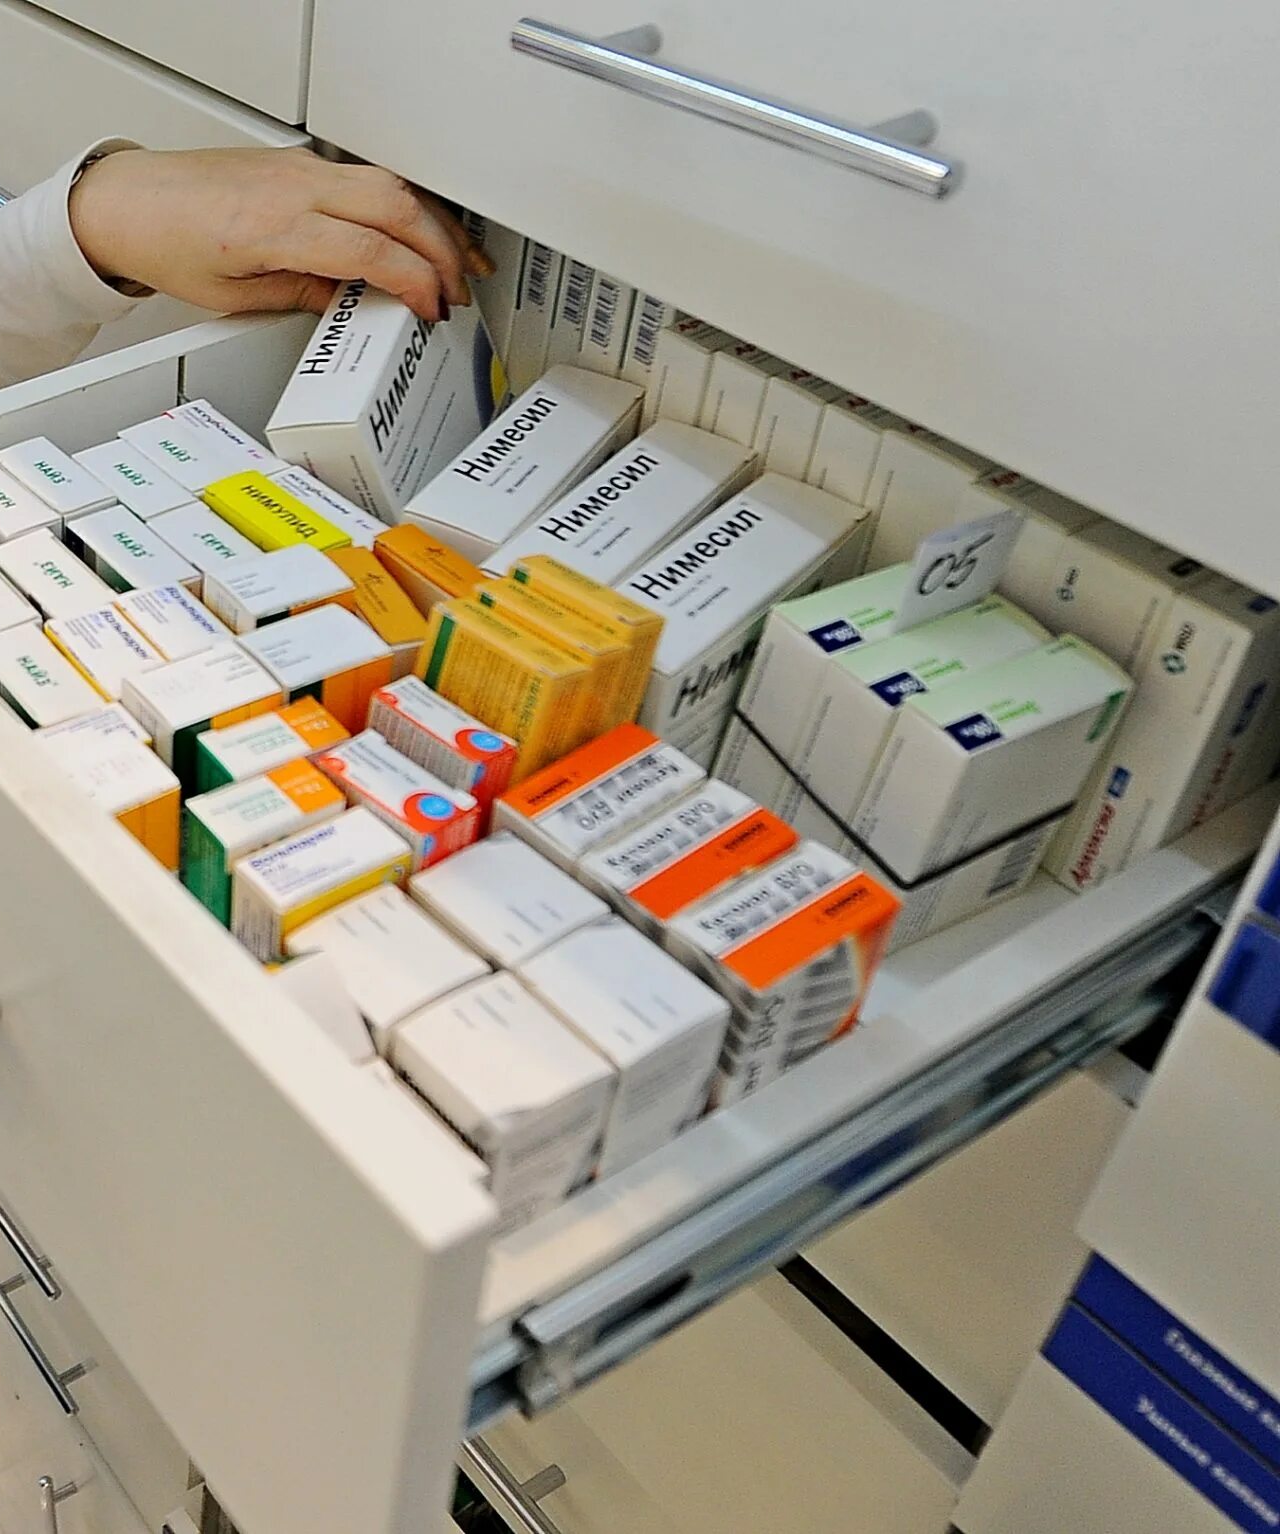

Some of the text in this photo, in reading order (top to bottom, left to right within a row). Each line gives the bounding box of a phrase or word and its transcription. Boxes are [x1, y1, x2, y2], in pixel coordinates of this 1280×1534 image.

[299, 276, 366, 376] Нимеси
[370, 319, 436, 453] Нимеси
[453, 393, 559, 483] Нимесил
[240, 484, 319, 539] НИМУЛИД
[539, 452, 661, 542] Нимесил
[630, 507, 764, 600] Нимесил
